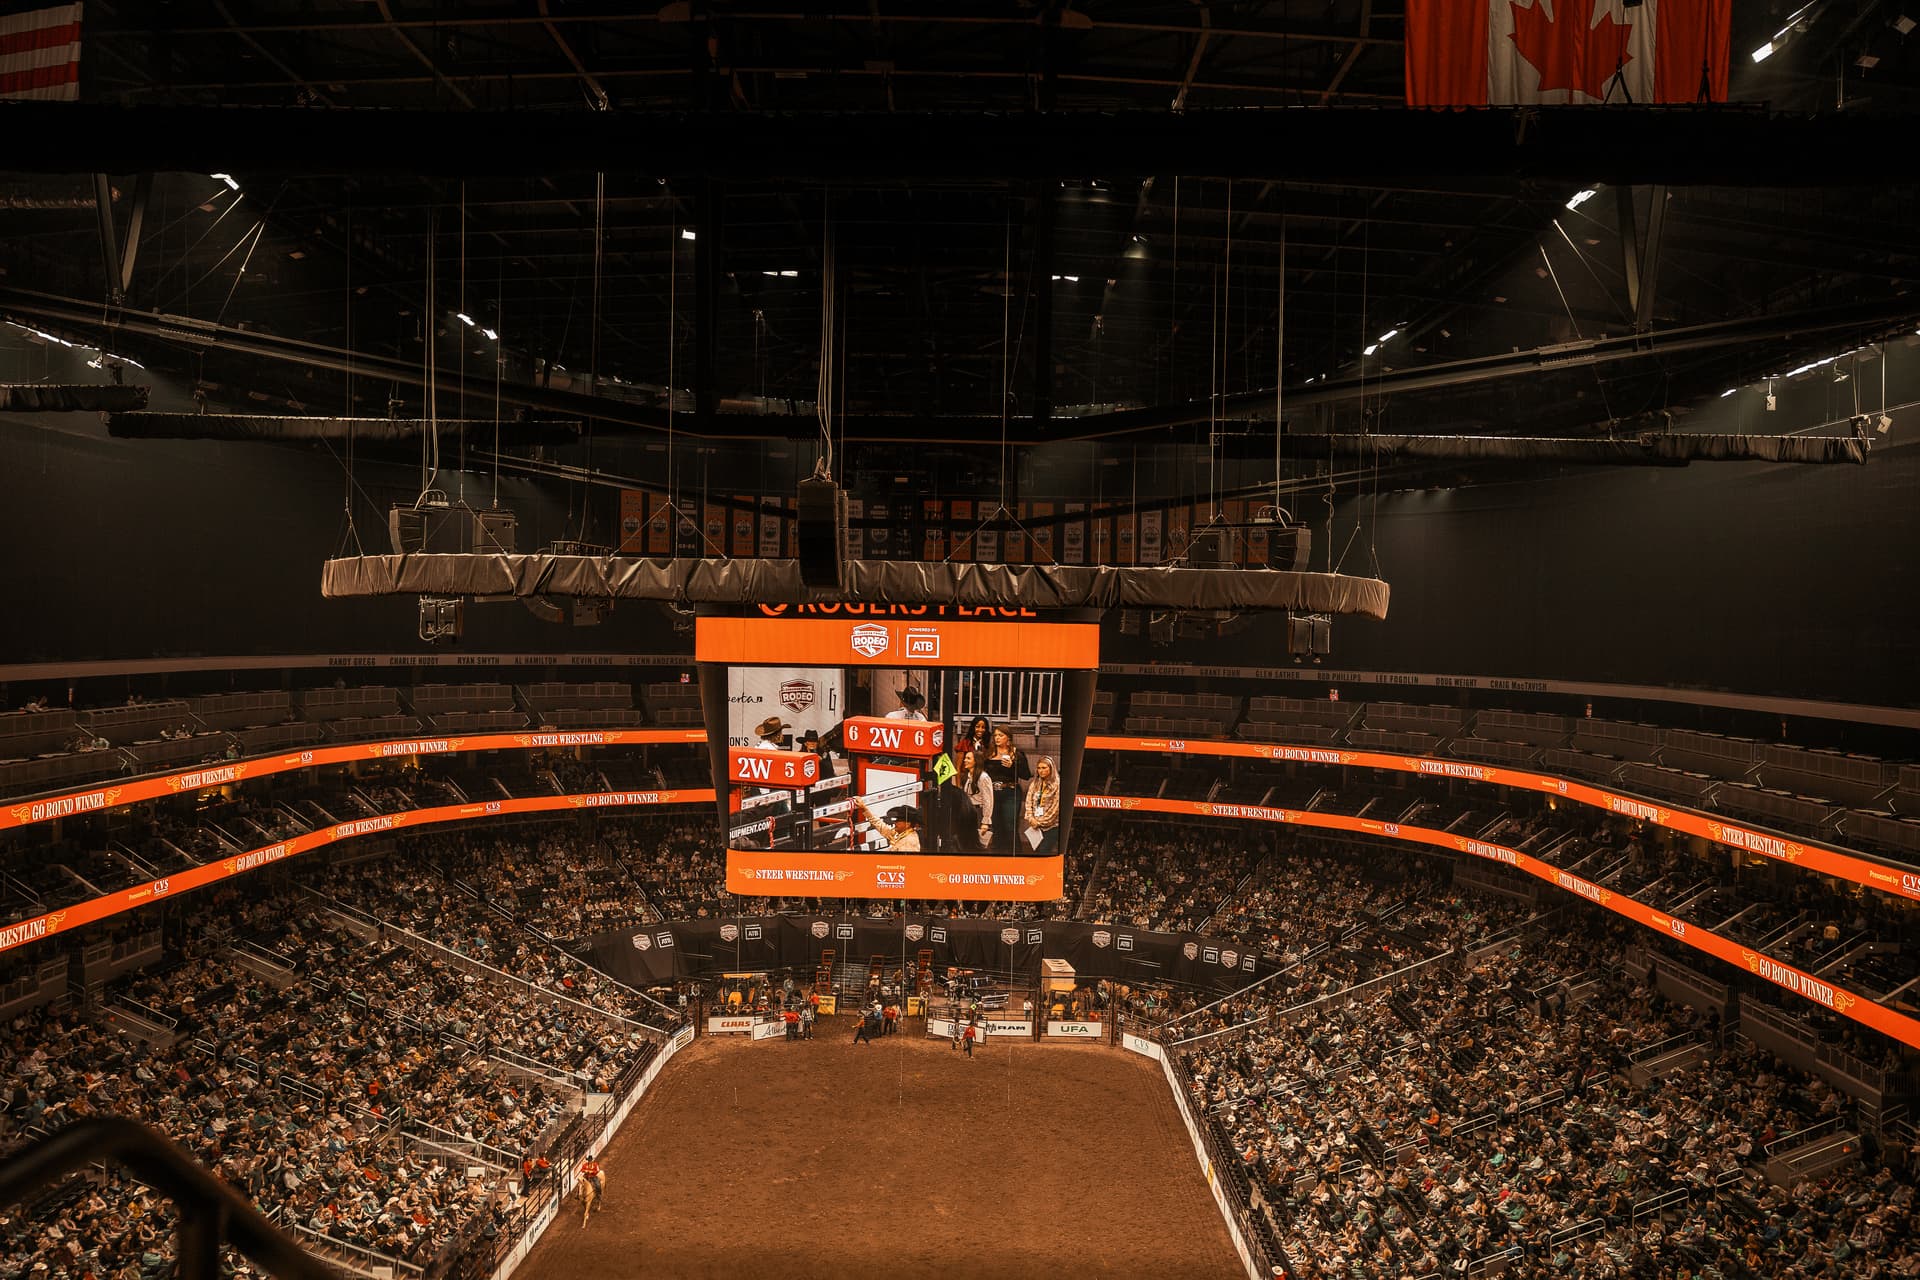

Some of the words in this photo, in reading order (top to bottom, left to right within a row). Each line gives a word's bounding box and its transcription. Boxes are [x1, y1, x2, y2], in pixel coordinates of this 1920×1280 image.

[854, 637, 887, 646] RODEO
[912, 640, 934, 652] ATB
[782, 692, 813, 703] RODEO
[532, 734, 558, 745] STEER
[559, 733, 603, 745] WRESTLING
[848, 725, 859, 741] 6
[869, 727, 904, 749] 2W
[914, 730, 924, 746] 6
[383, 745, 392, 756] GO
[392, 743, 418, 755] ROUND
[420, 740, 448, 753] WINNER
[1273, 748, 1284, 758] GO
[1285, 749, 1310, 760] ROUND
[1311, 751, 1340, 764] WINNER
[737, 756, 773, 780] 2W
[784, 762, 795, 778] 5
[1421, 760, 1443, 773] STEER
[1444, 763, 1483, 779] WRESTLING
[180, 774, 201, 789] STEER
[202, 766, 235, 786] WRESTLING
[32, 804, 45, 820] GO
[46, 799, 74, 818] ROUND
[75, 793, 105, 810] WINNER
[586, 796, 598, 806] GO
[599, 795, 625, 805] ROUND
[626, 793, 658, 804] WINNER
[1090, 797, 1122, 809] WINNER
[1212, 805, 1239, 817] STEER
[1240, 807, 1285, 821] WRESTLING
[336, 822, 355, 838] STEER
[356, 817, 393, 835] WRESTLING
[1467, 840, 1476, 853] GO
[1476, 842, 1496, 859] ROUND
[1722, 827, 1744, 844] STEER
[1744, 832, 1786, 858] WRESTLING
[236, 856, 245, 871] GO
[756, 870, 784, 880] STEER
[785, 870, 834, 881] WRESTLING
[876, 871, 906, 882] CVS
[948, 874, 961, 884] GO
[962, 874, 991, 885] ROUND
[992, 874, 1025, 885] WINNER
[154, 878, 169, 892] CVS
[0, 918, 46, 949] RESTLING
[1672, 919, 1686, 934] CVS
[1759, 958, 1771, 978] GO
[1772, 963, 1799, 992] ROUND
[1800, 976, 1834, 1008] WINNER
[721, 1020, 751, 1028] CLAAS
[1060, 1025, 1089, 1033] UFA
